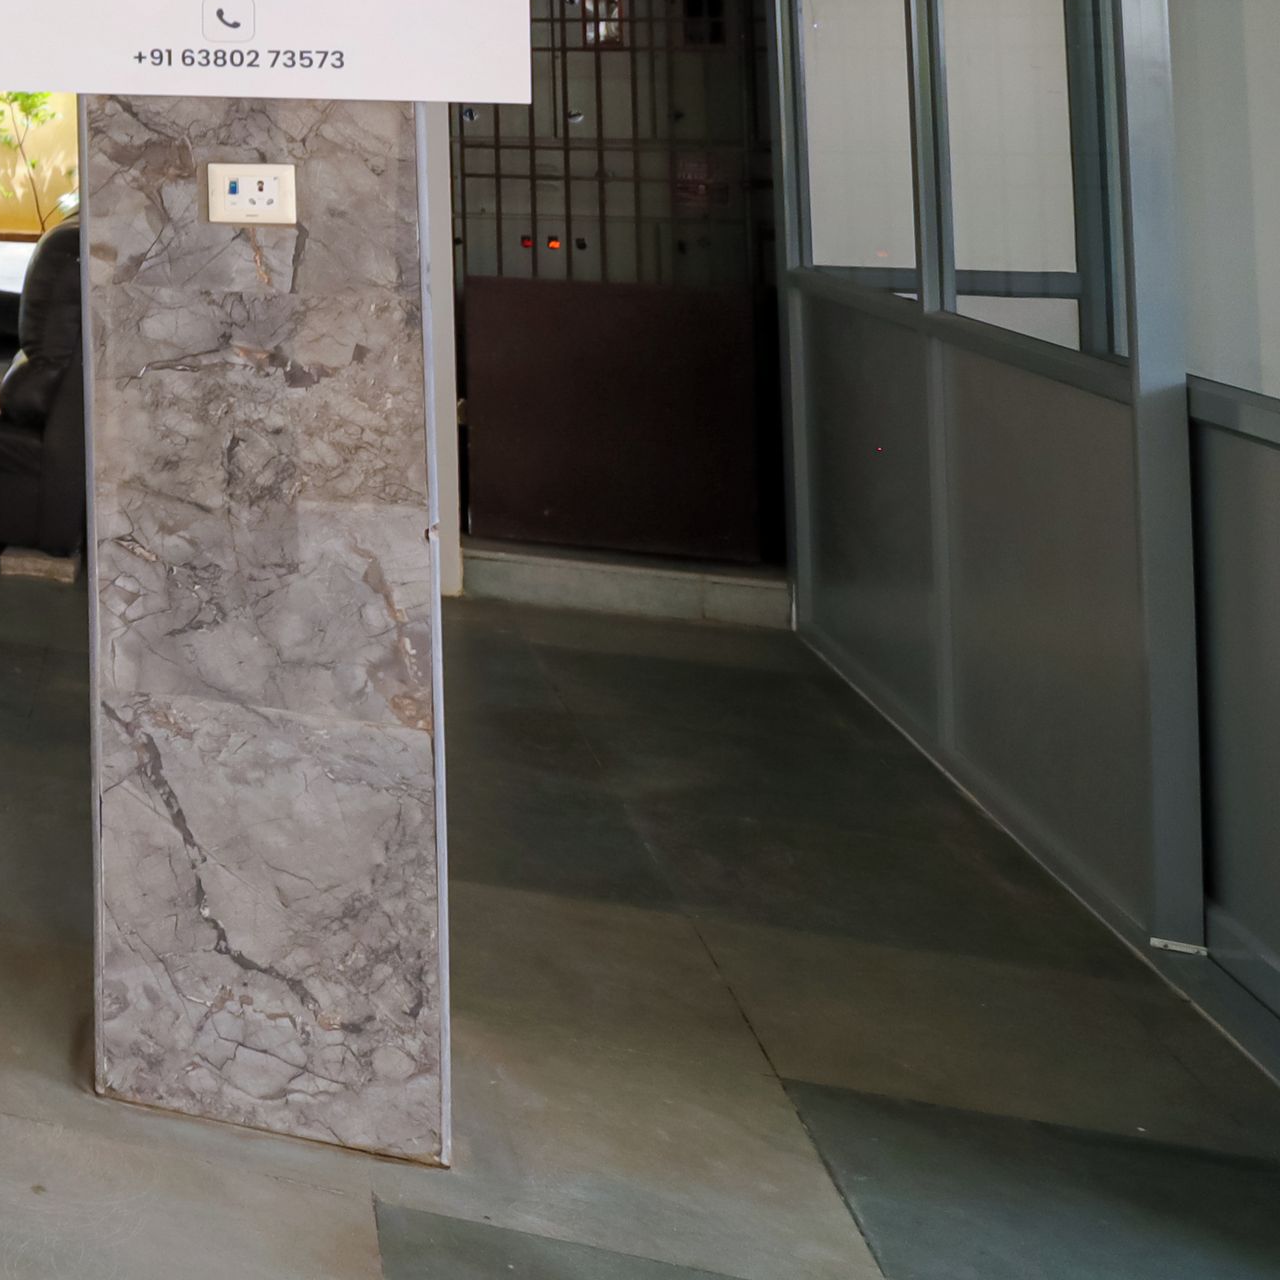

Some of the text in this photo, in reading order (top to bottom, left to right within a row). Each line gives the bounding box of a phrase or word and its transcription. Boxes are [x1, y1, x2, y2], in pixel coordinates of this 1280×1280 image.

[132, 47, 345, 70] +91 63802 73573
